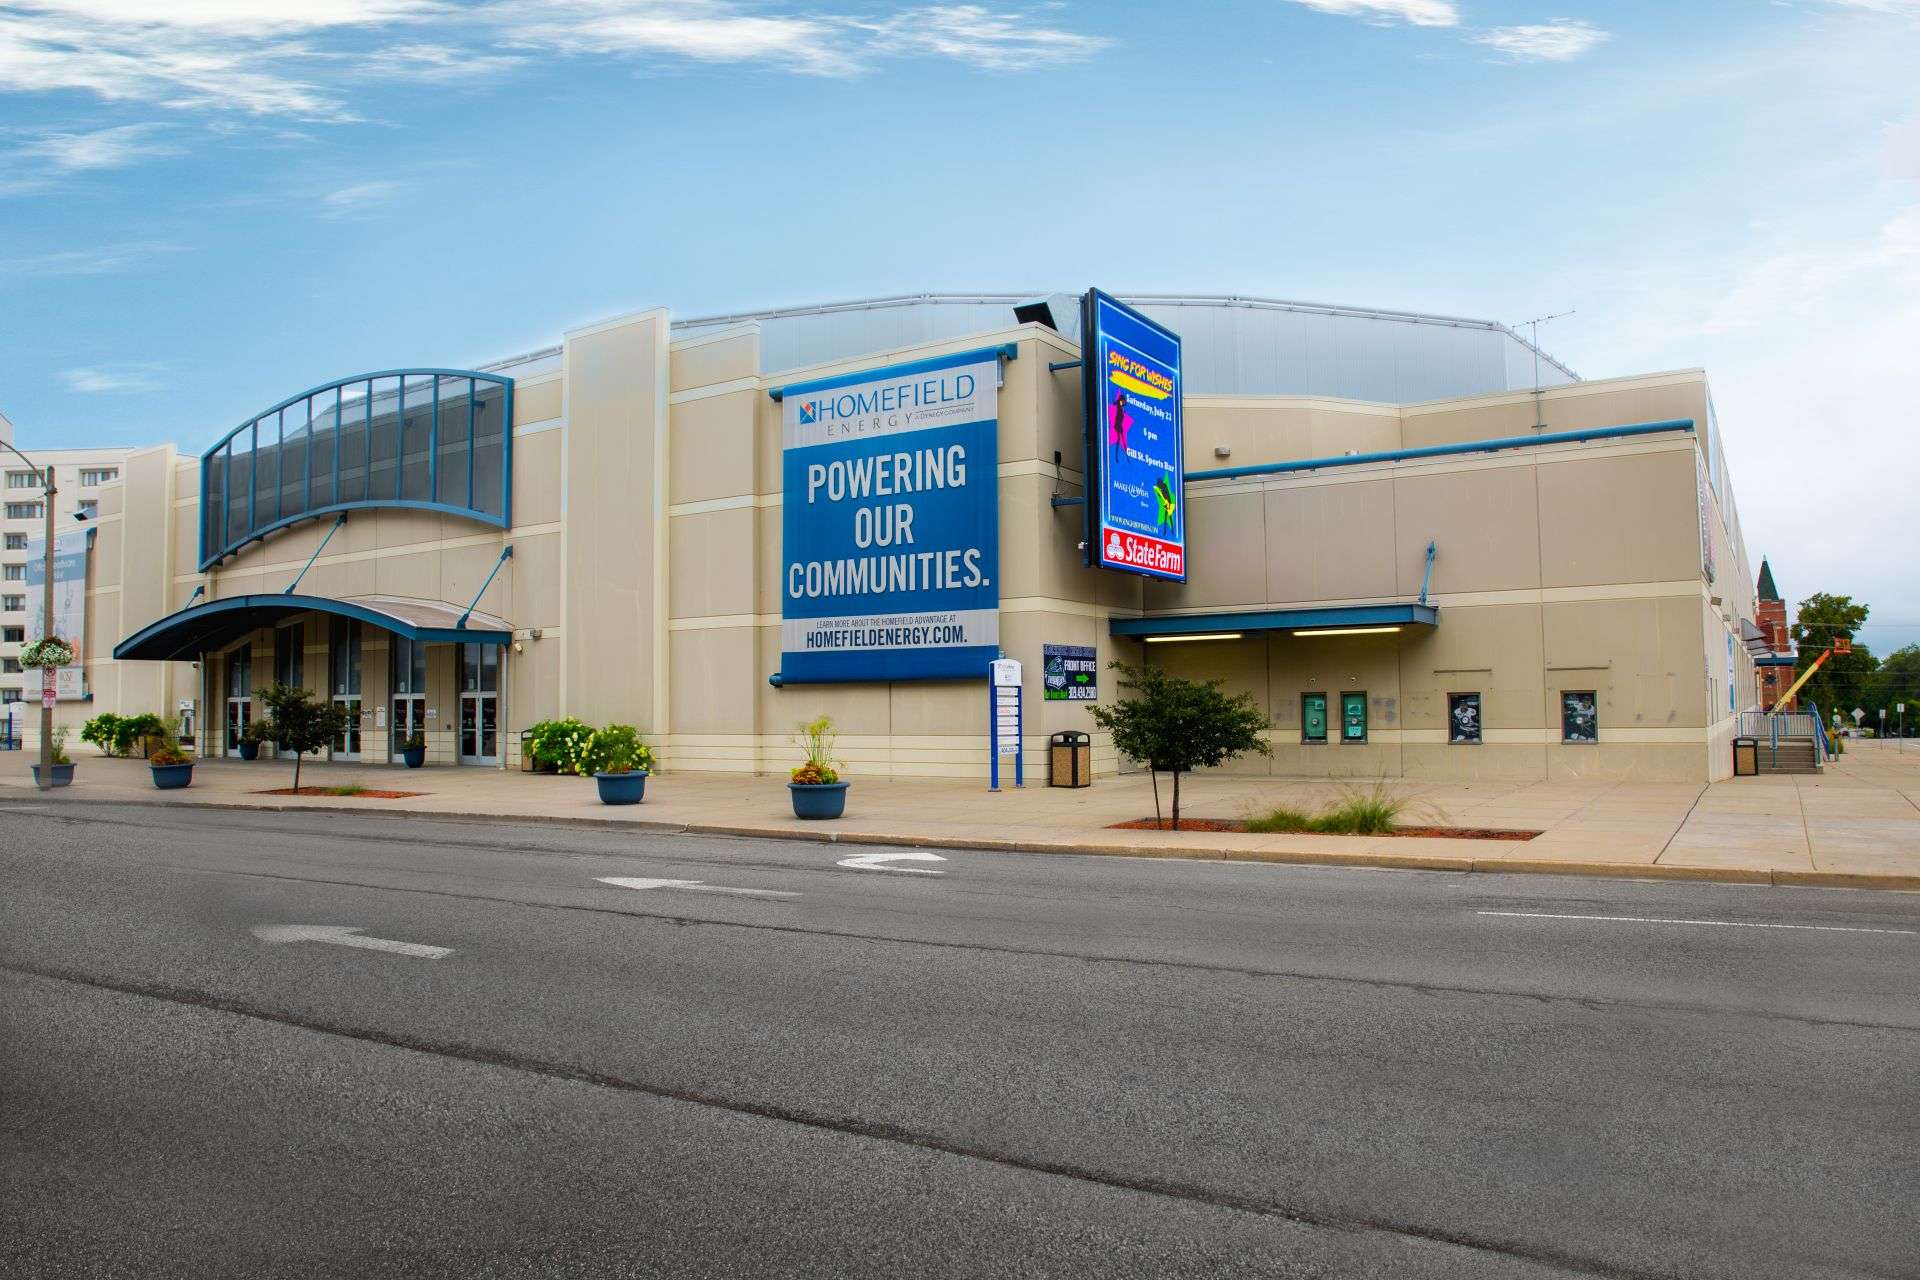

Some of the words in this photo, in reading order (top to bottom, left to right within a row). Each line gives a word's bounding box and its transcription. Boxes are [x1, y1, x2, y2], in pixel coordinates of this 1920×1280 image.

[1129, 361, 1146, 380] FOR
[819, 374, 975, 421] HOMEFIELD
[827, 413, 912, 436] ENERGY
[1147, 431, 1158, 441] pm
[808, 444, 966, 504] POWERING
[1145, 454, 1164, 469] Sports
[1163, 461, 1175, 472] Bar
[855, 503, 914, 549] OUR
[789, 548, 990, 599] COMMUNITIES.
[816, 619, 834, 629] LEARN
[834, 618, 850, 628] MORE
[851, 617, 869, 628] ABOUT
[870, 617, 882, 627] THE
[881, 615, 914, 626] HOMEFIELD
[914, 614, 948, 625] ADVANTAGE
[949, 614, 956, 622] AT
[807, 625, 968, 648] HOMEFIELDENERGY.COM.
[1080, 660, 1096, 672] OFFICE
